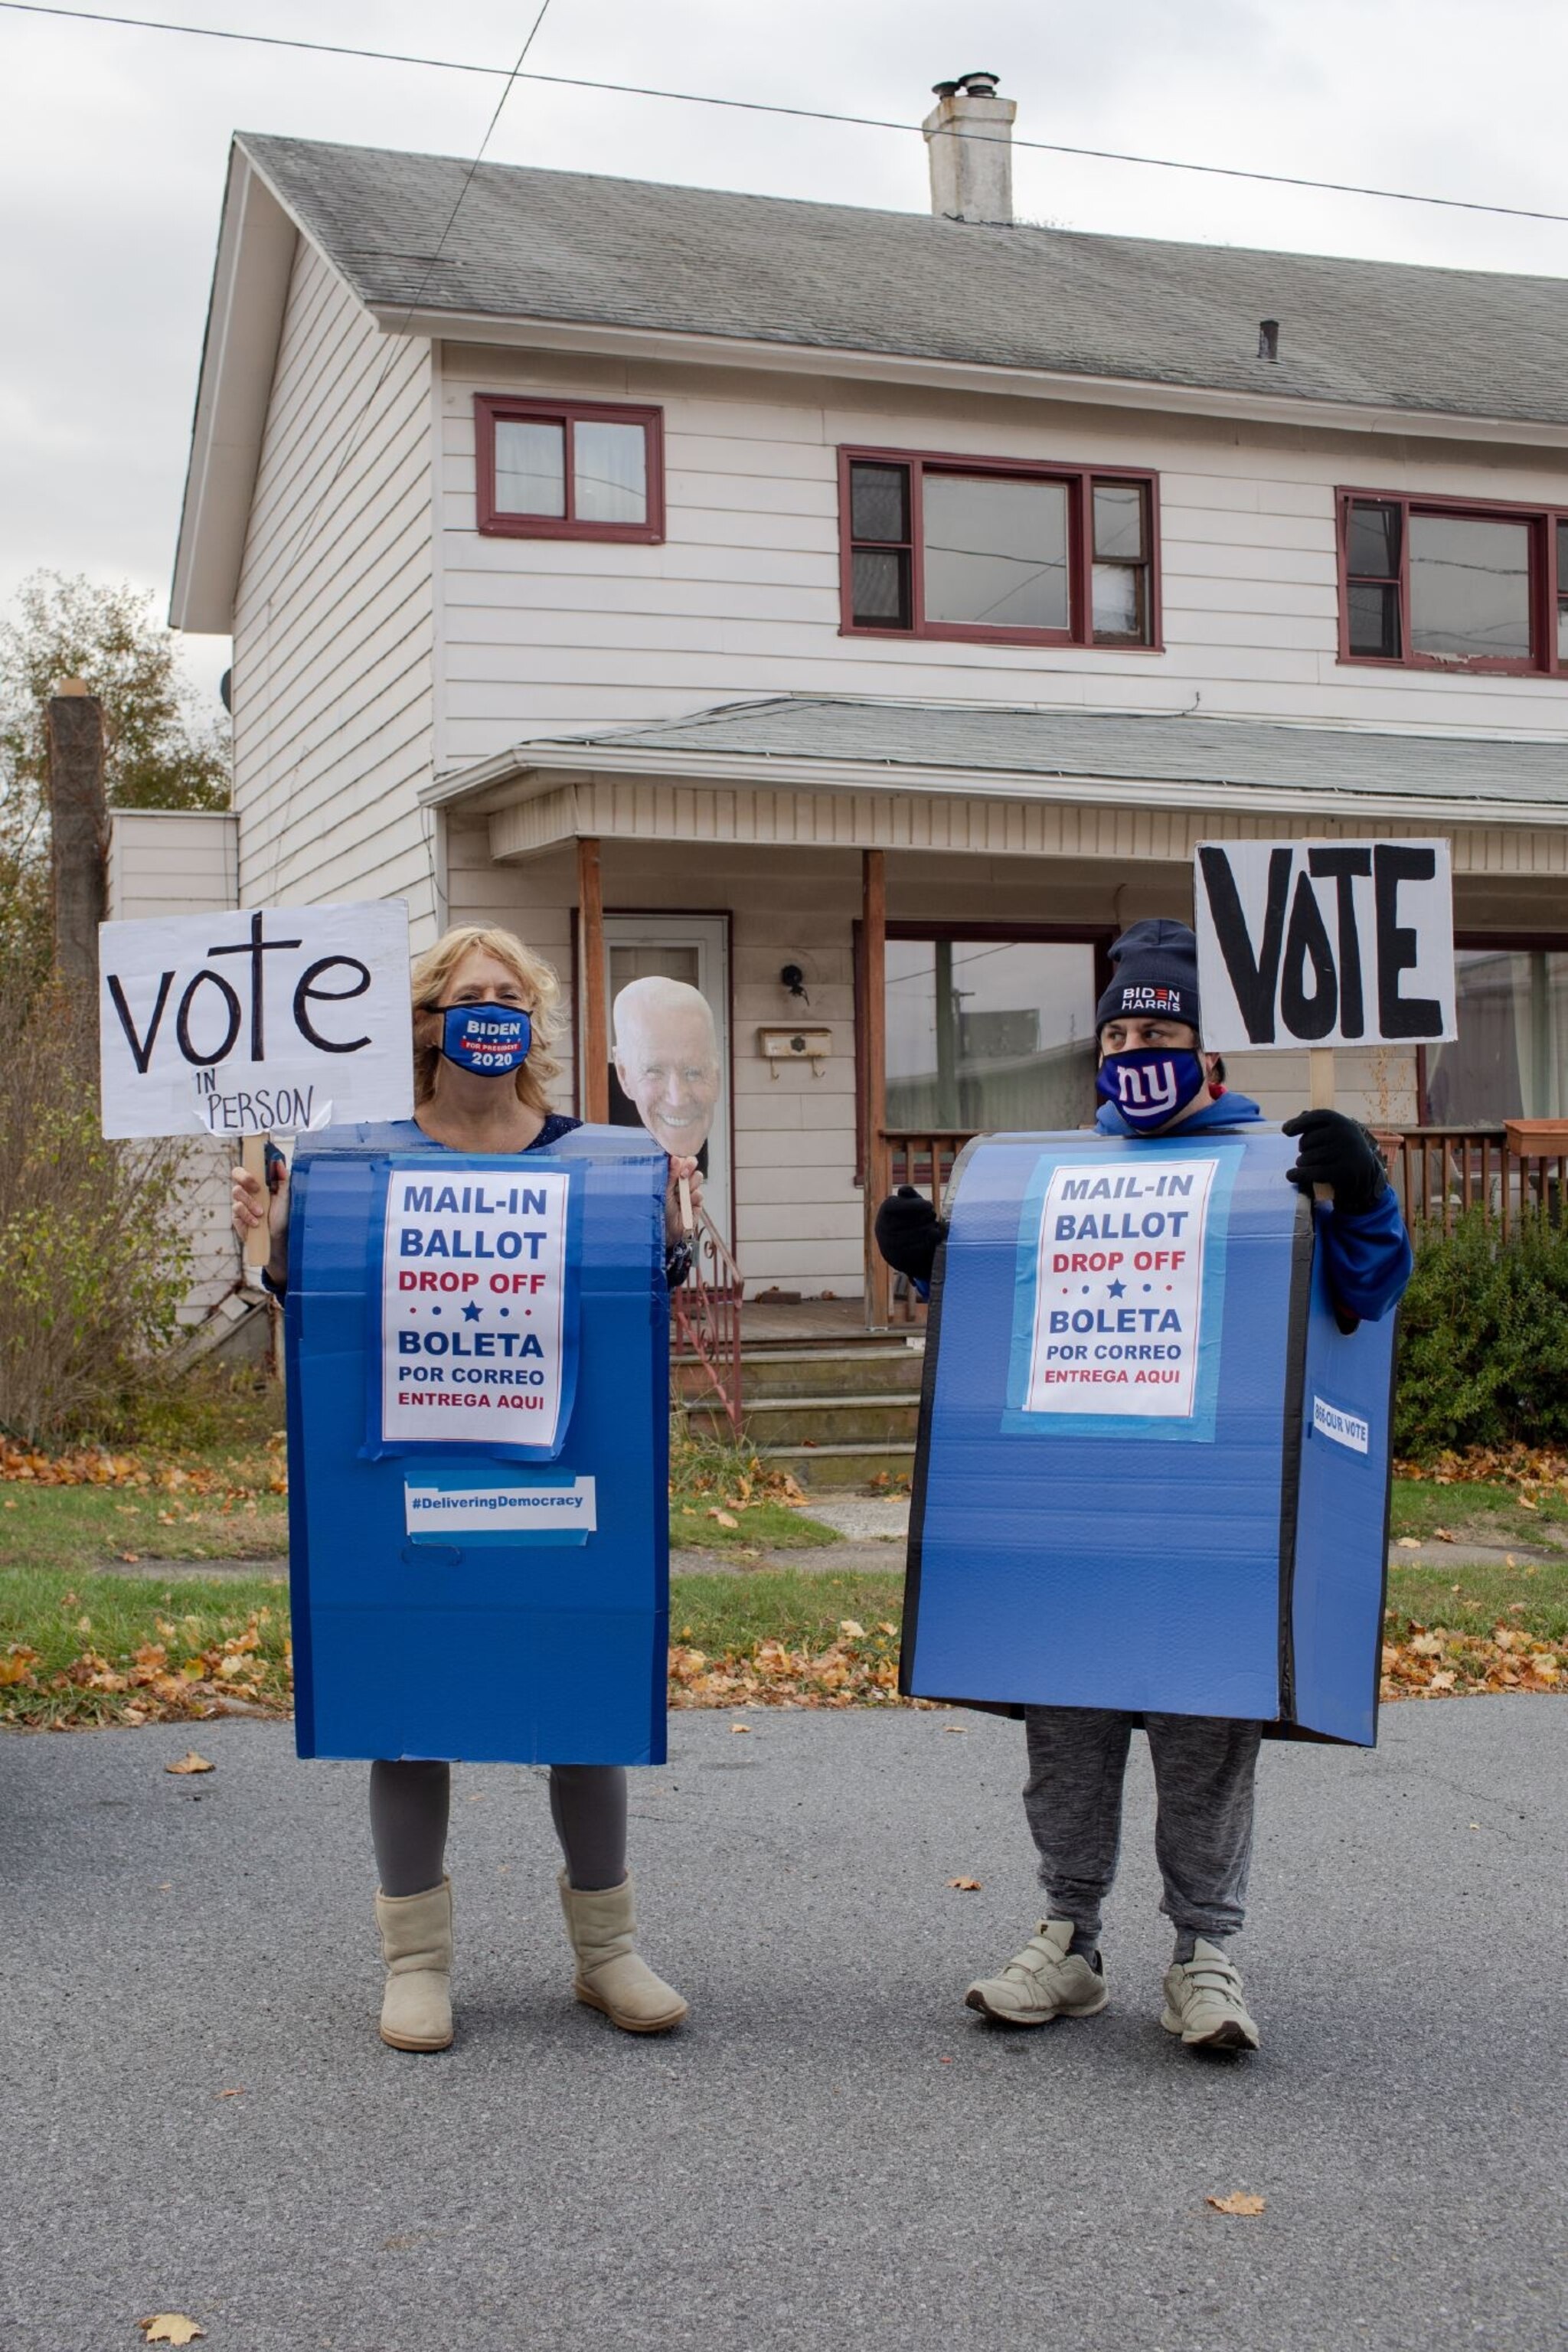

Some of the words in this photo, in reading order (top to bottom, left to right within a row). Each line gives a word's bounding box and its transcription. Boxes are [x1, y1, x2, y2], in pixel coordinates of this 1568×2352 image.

[1198, 844, 1443, 1044] VOTE
[1122, 987, 1181, 1001] BIDEN
[1122, 998, 1181, 1012] HARRIS
[467, 1021, 521, 1035] BIDEN
[472, 1052, 512, 1066] 2020
[196, 1068, 216, 1095] IN
[207, 1085, 314, 1129] PERSON
[1061, 1174, 1194, 1201] MAIL-IN
[403, 1186, 547, 1215] MAIL-IN
[1054, 1211, 1189, 1241] BALLOT
[400, 1228, 547, 1259] BALLOT
[1053, 1252, 1124, 1273] DROP
[1133, 1251, 1186, 1271] OFF
[399, 1271, 479, 1292] DROP
[489, 1273, 547, 1294] OFF
[1050, 1308, 1182, 1334] BOLETA
[398, 1331, 544, 1358] BOLETA
[1047, 1346, 1087, 1361] POR
[1094, 1344, 1181, 1360] CORREO
[399, 1366, 444, 1382] POR
[452, 1367, 544, 1386] CORREO
[1044, 1369, 1129, 1383] ENTREGA
[1134, 1370, 1180, 1384] AQUI
[398, 1393, 491, 1407] ENTREGA
[497, 1395, 544, 1410] AQUI
[1345, 1419, 1366, 1441] VOTE
[412, 1495, 583, 1510] #DeliveringDemocracy
